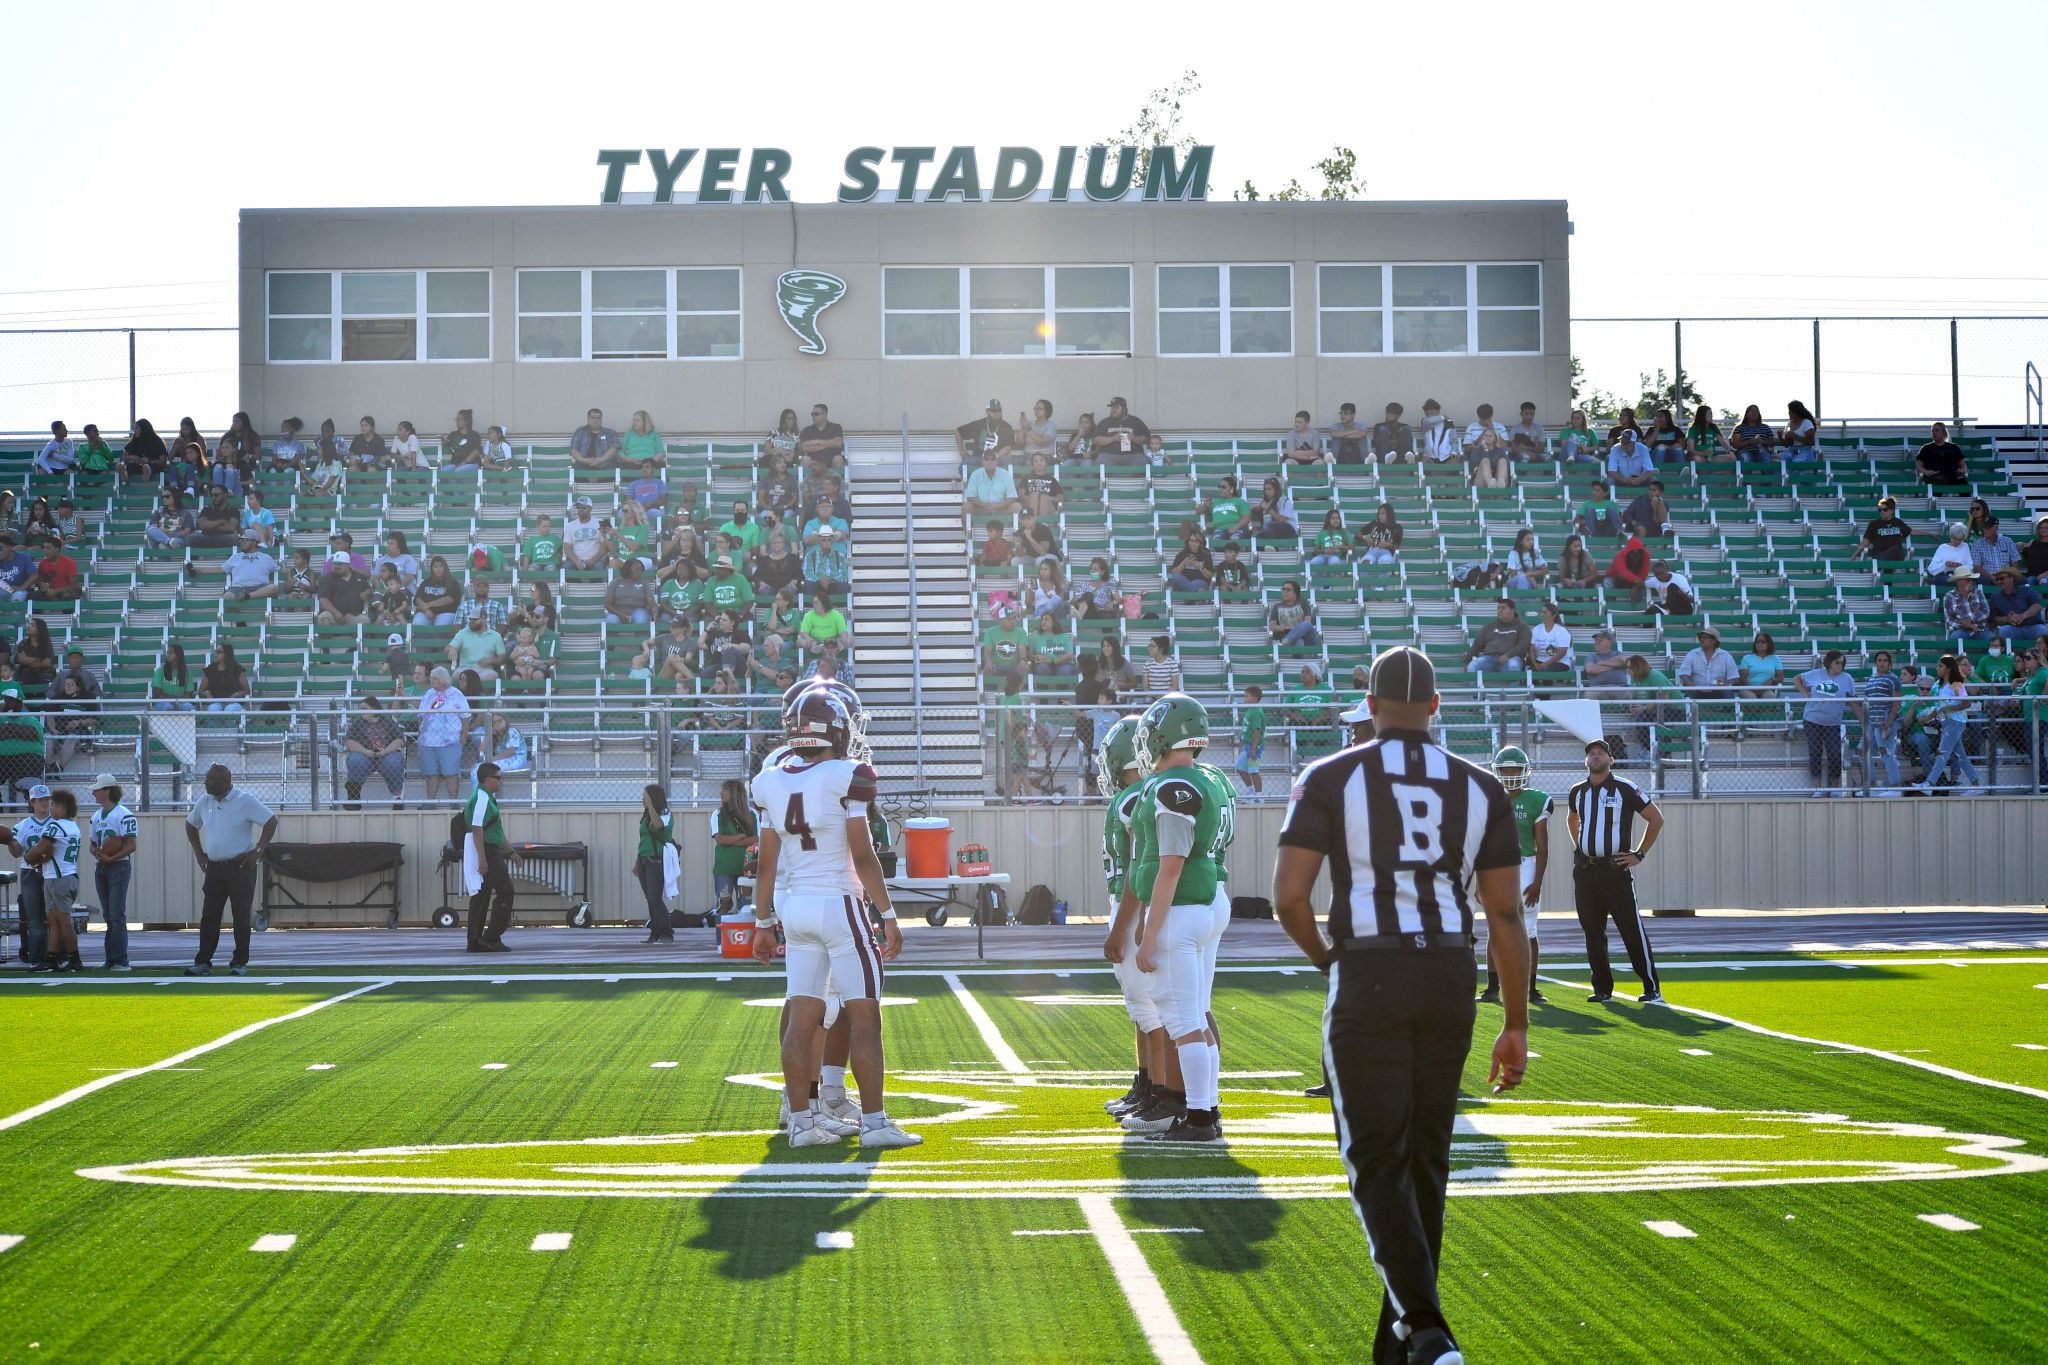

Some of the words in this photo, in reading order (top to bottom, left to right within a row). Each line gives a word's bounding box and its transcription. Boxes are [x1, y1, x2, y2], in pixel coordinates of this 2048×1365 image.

[597, 148, 792, 204] TYER
[837, 145, 1214, 202] STADIUM
[123, 818, 137, 833] 72
[784, 791, 818, 852] 4
[1391, 782, 1445, 866] B
[734, 931, 744, 942] G
[776, 945, 785, 955] G
